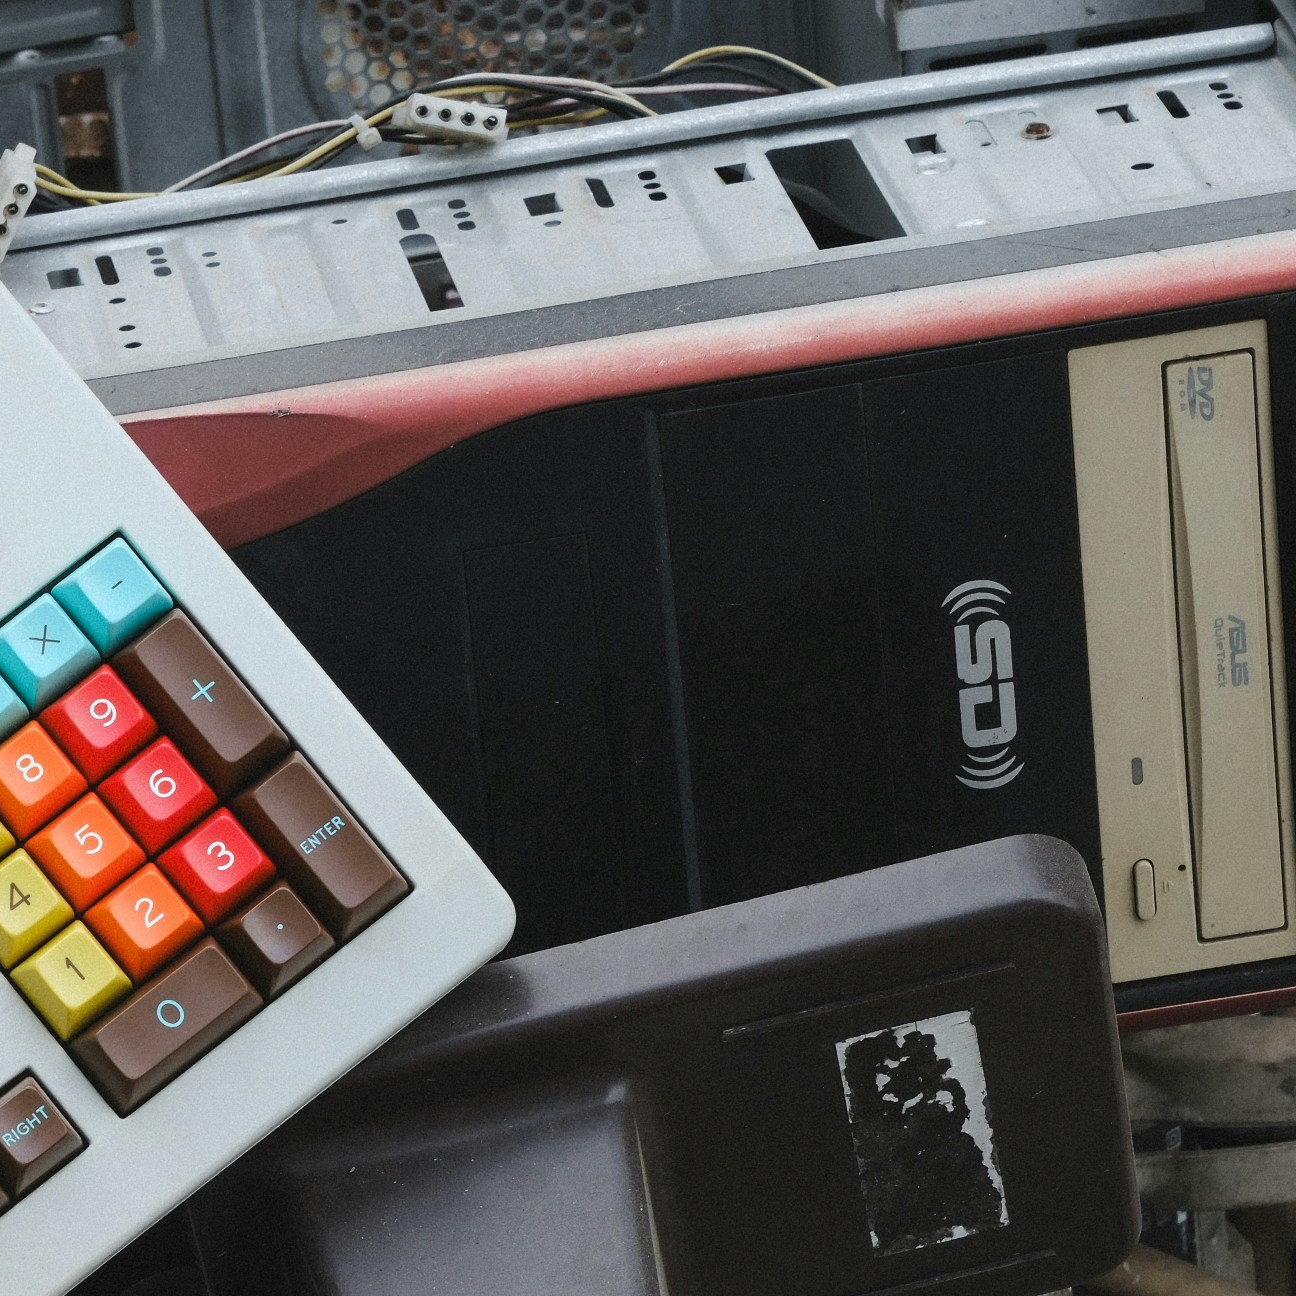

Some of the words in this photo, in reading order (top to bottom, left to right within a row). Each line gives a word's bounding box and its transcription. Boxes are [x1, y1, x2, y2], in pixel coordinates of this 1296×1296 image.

[1195, 366, 1215, 422] DVD
[1228, 614, 1250, 688] ASUS
[953, 619, 1019, 748] SD
[90, 699, 116, 726] 9
[16, 754, 43, 782] 8
[149, 770, 176, 798] 6
[75, 825, 103, 854] 5
[300, 816, 344, 854] ENTER
[207, 842, 234, 870] 3
[10, 882, 30, 910] 4
[135, 898, 164, 928] 2
[65, 957, 85, 980] 1
[1, 1104, 51, 1148] RIGHT
